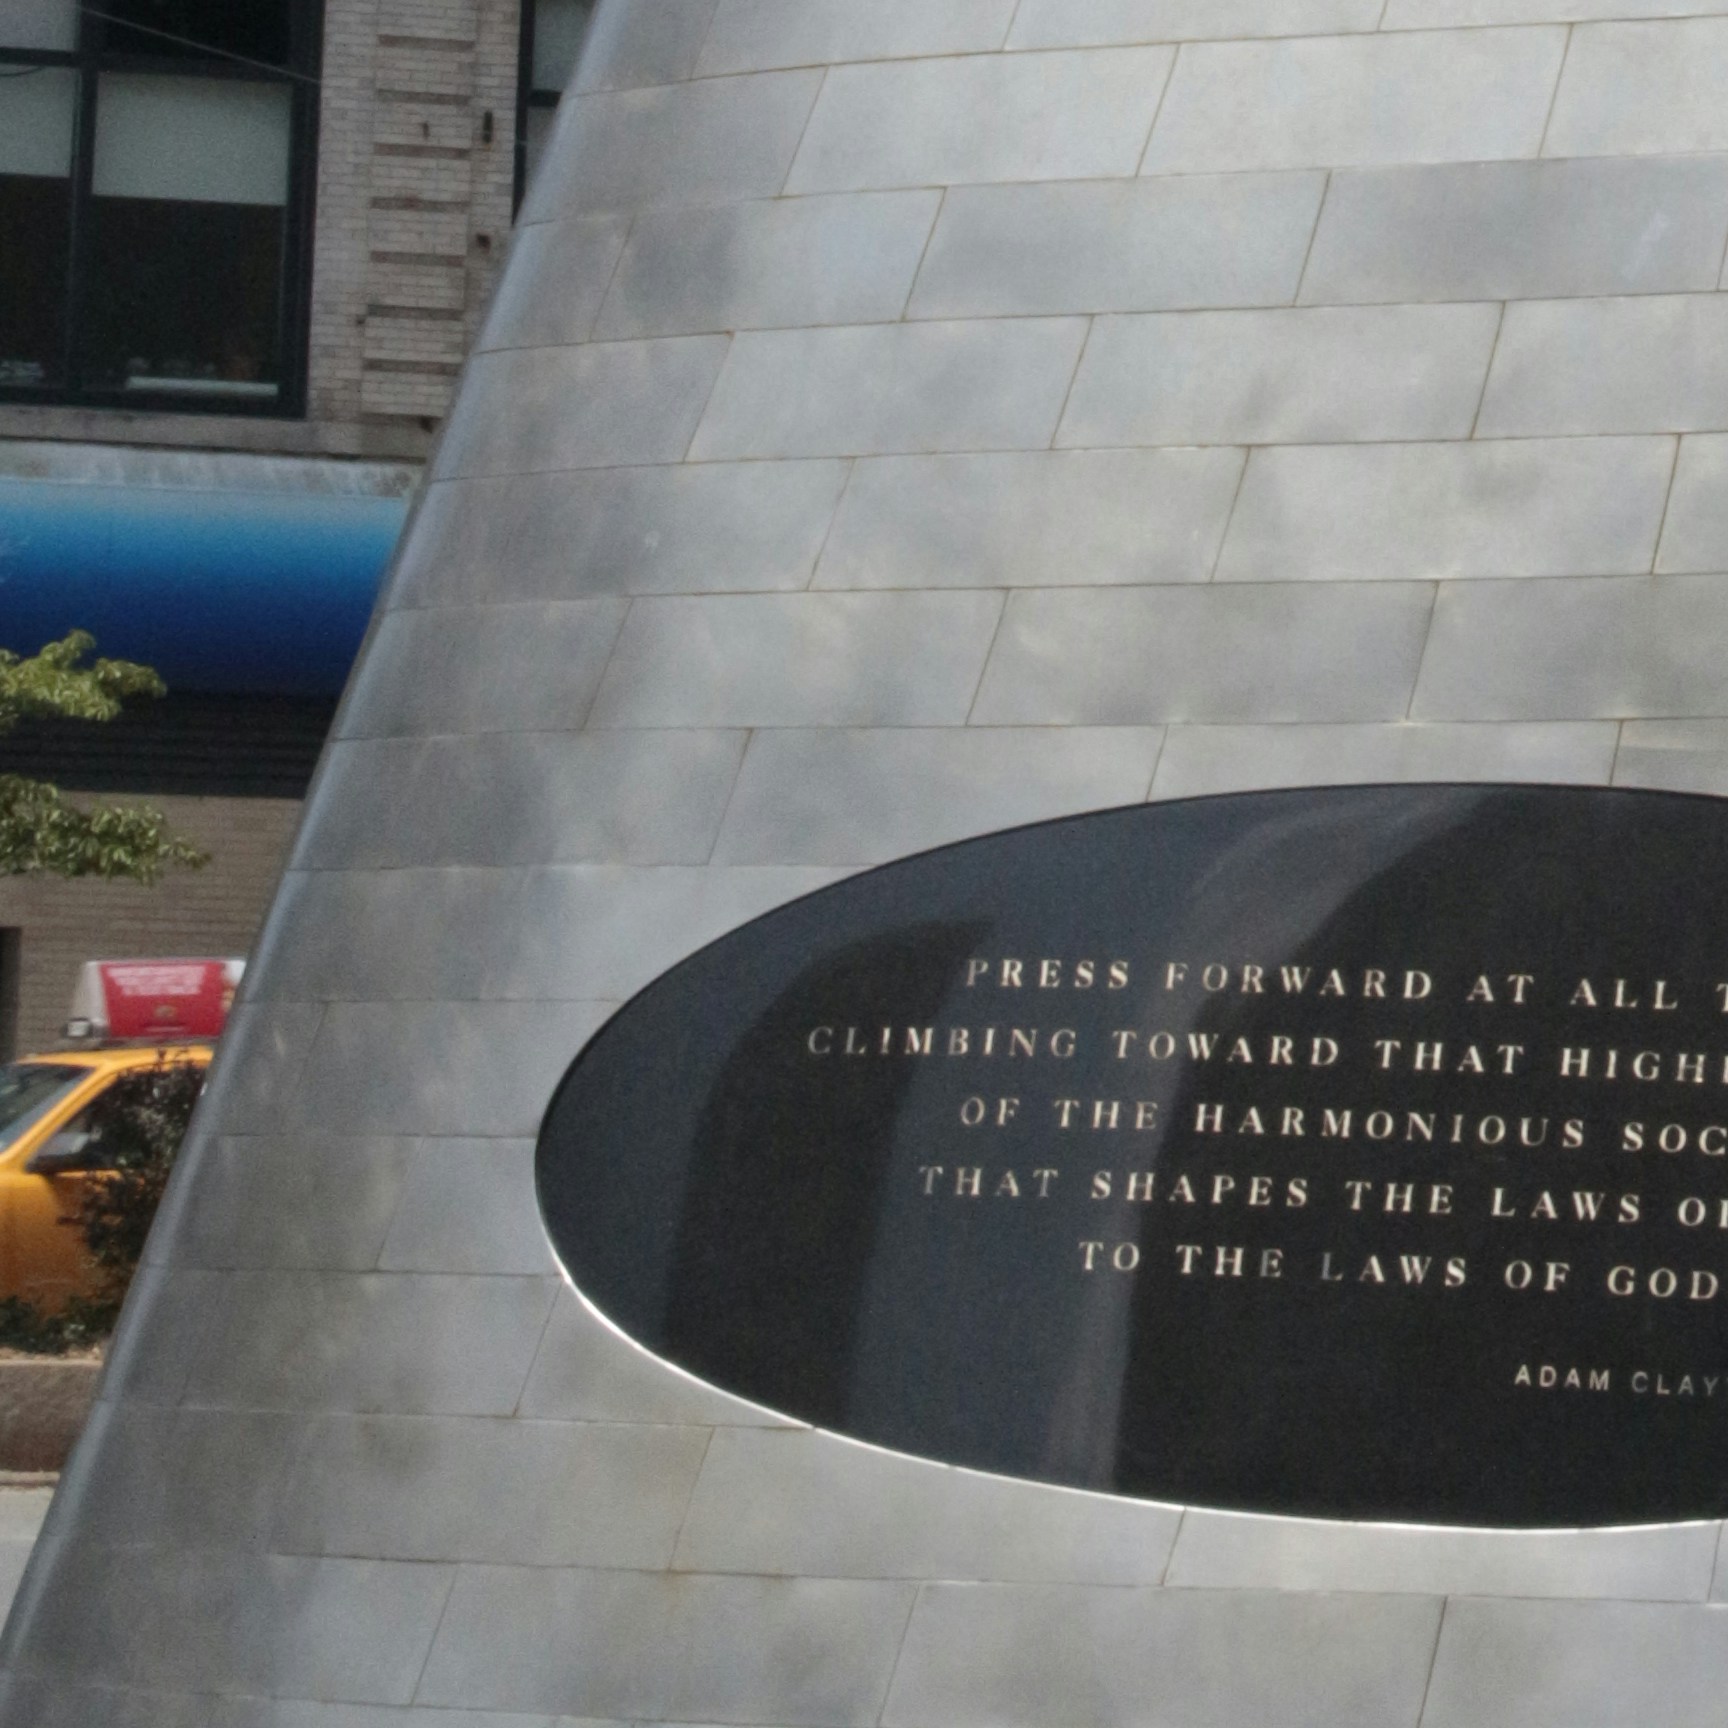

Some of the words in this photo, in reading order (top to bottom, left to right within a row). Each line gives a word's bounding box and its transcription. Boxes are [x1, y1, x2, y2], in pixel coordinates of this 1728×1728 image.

[965, 958, 1129, 990] PRESS
[1164, 961, 1434, 1001] FORWARD
[1466, 973, 1535, 1005] AT
[1569, 977, 1678, 1011] ALL
[807, 1025, 1077, 1058] CLIMBING
[1112, 1030, 1340, 1067] TOWARD
[1373, 1038, 1525, 1076] THAT
[959, 1096, 1020, 1127] OF
[1053, 1098, 1159, 1131] THE
[1194, 1102, 1585, 1149] HARMONIOUS
[918, 1165, 1059, 1198] THAT
[1090, 1170, 1309, 1208] SHAPES
[1344, 1180, 1454, 1215] THE
[1490, 1186, 1641, 1224] LAWS
[1079, 1241, 1140, 1272] TO
[1175, 1244, 1284, 1279] THE
[1320, 1251, 1467, 1288] LAWS
[1503, 1259, 1571, 1293] OF
[1605, 1264, 1720, 1301] GOD
[1513, 1363, 1610, 1392] ADAM
